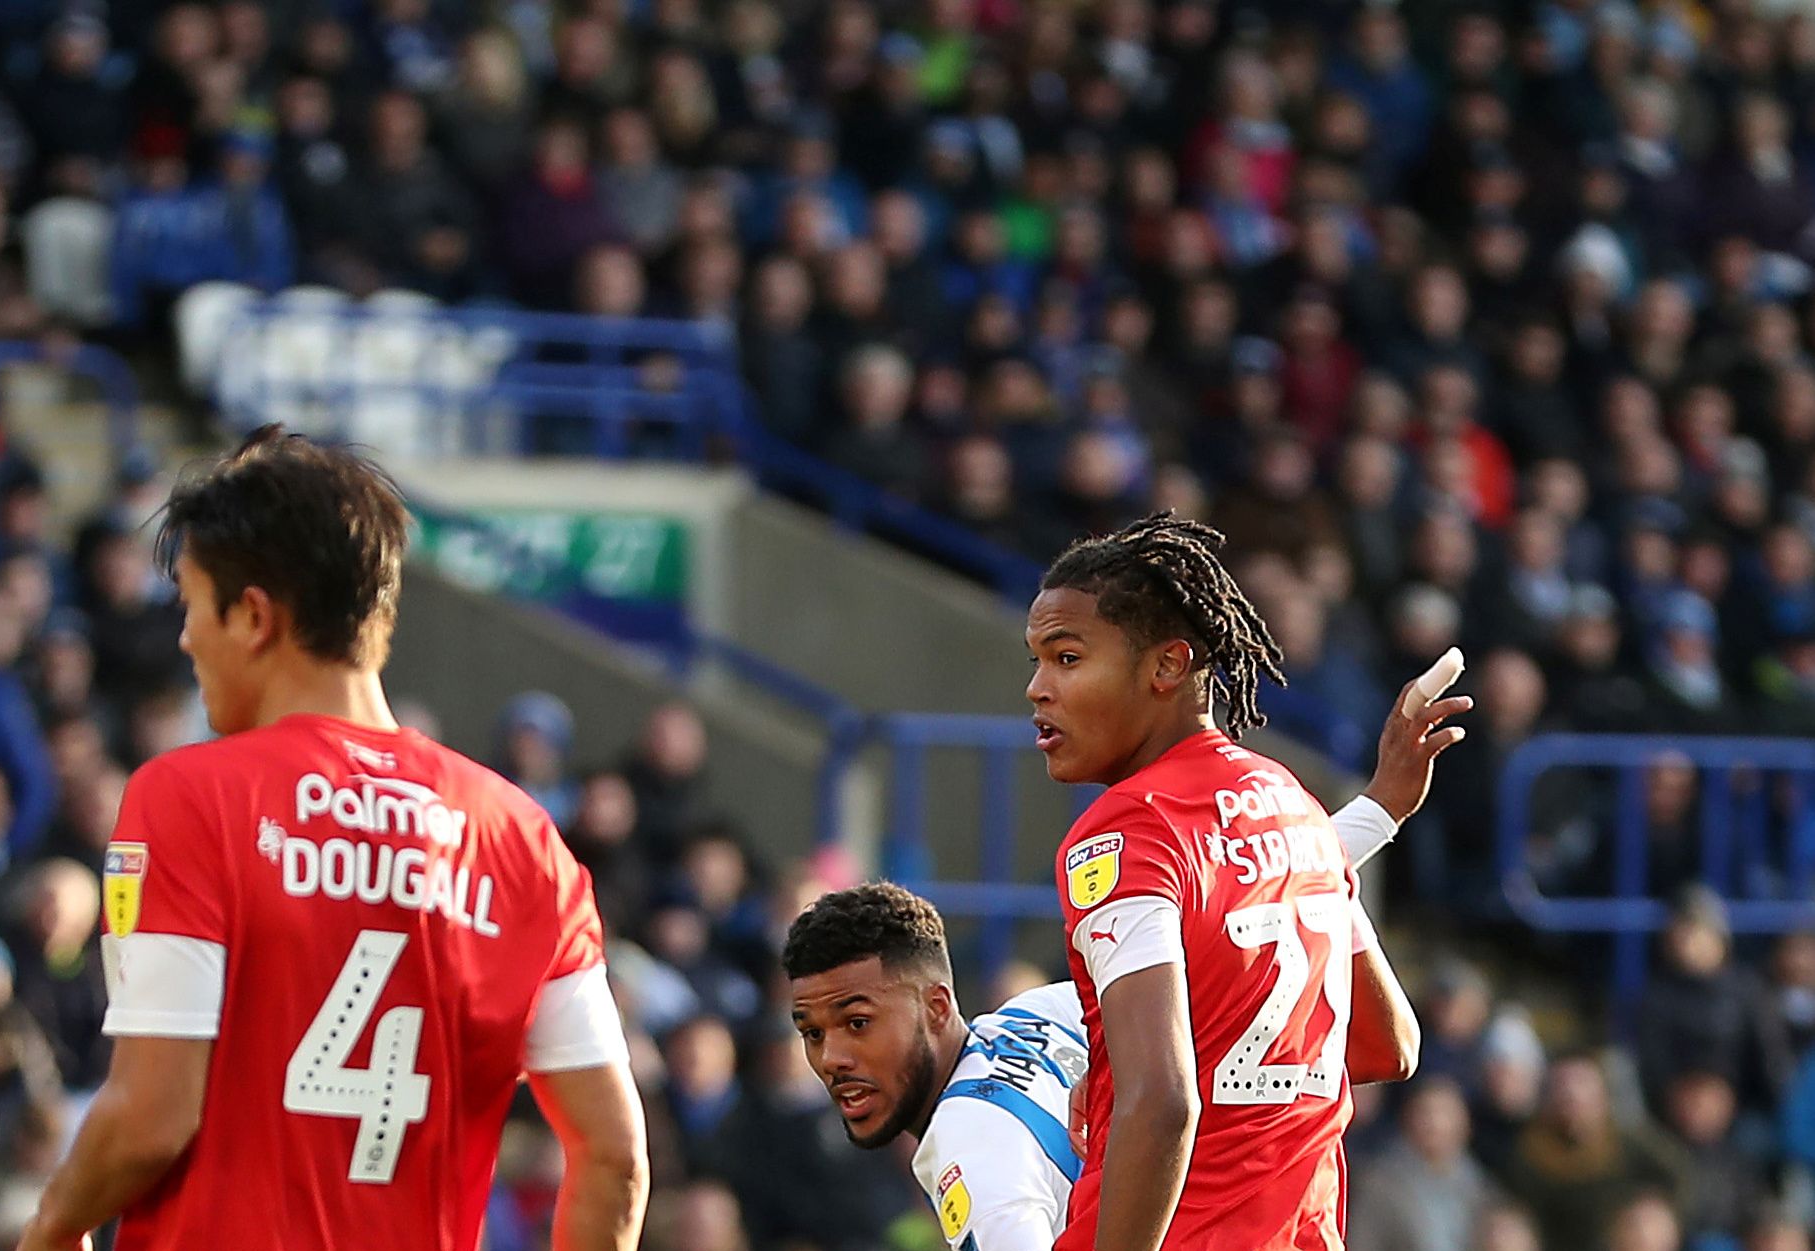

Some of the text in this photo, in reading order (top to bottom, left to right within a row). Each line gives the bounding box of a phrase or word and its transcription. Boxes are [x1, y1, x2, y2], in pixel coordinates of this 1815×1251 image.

[283, 837, 501, 938] DOUGALL
[1092, 840, 1118, 855] bet
[283, 929, 431, 1184] 4
